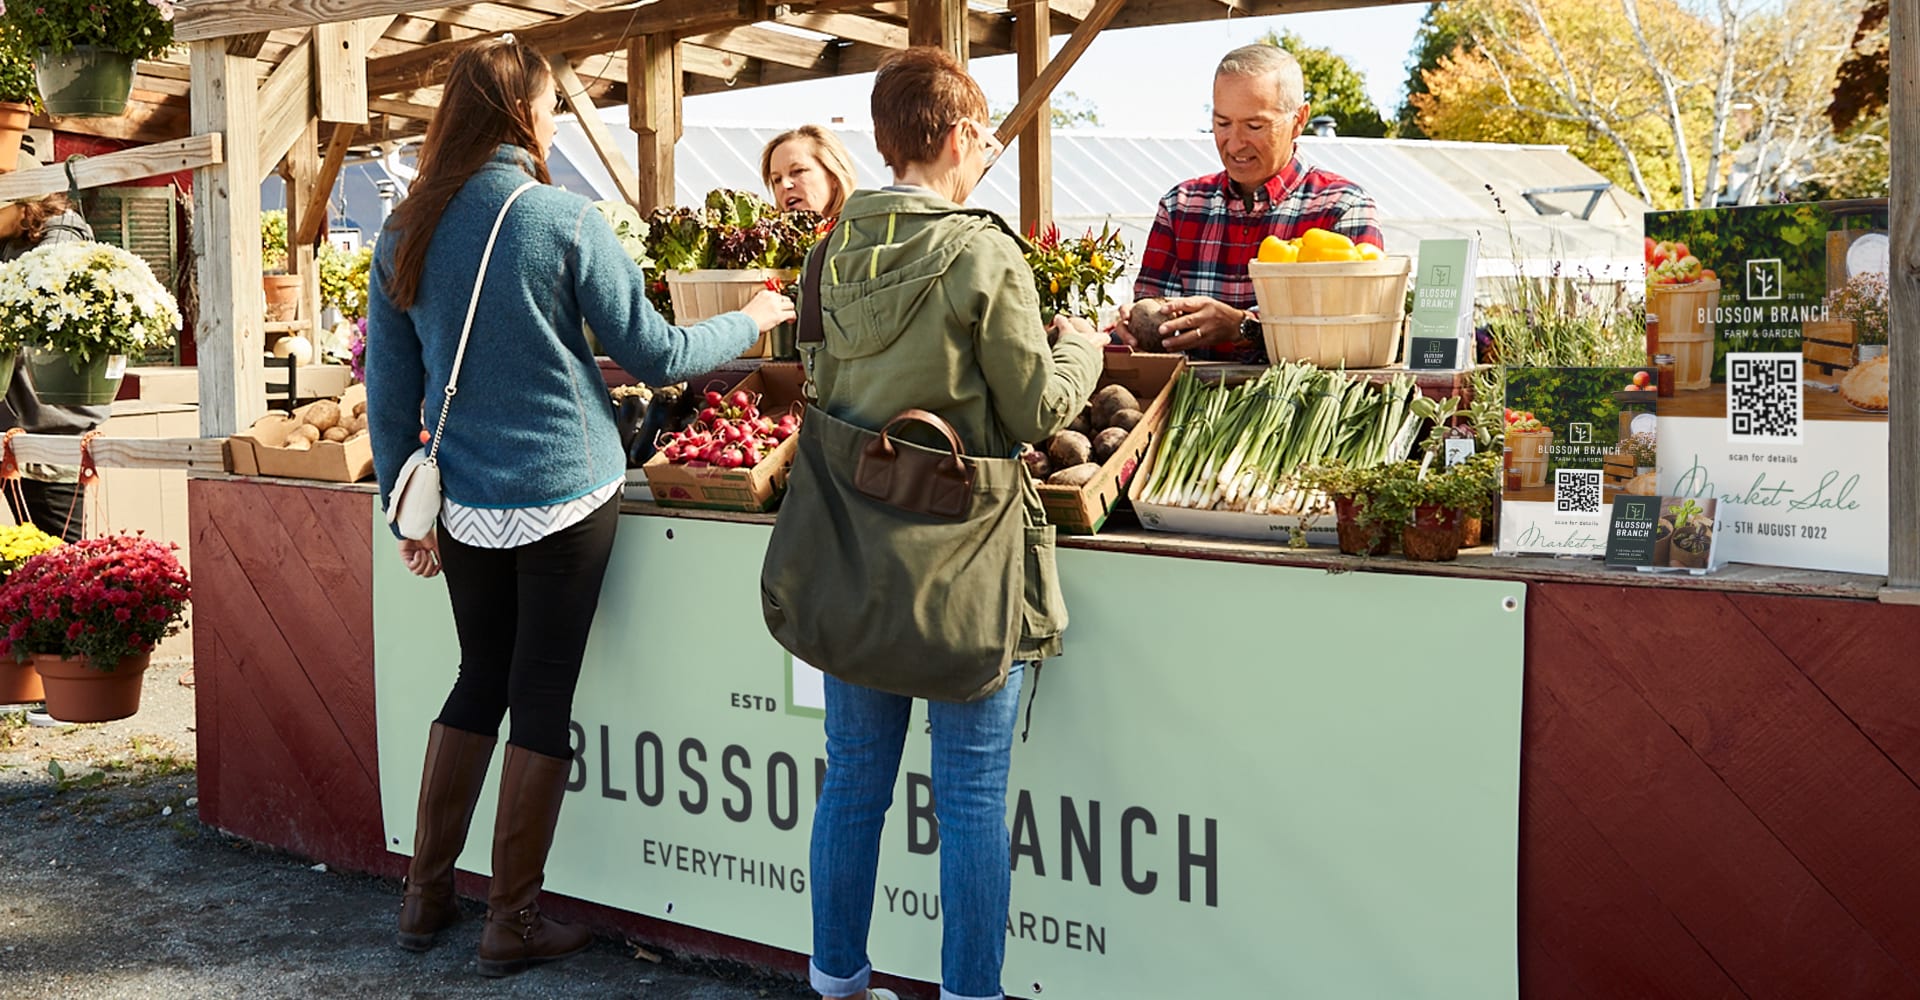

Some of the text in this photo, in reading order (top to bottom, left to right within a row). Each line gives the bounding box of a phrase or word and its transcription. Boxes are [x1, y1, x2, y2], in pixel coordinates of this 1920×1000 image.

[1420, 288, 1457, 298] BLOSSOM
[1420, 298, 1454, 309] BRANCH
[1697, 305, 1830, 324] BLOSSOM BRANCH
[1724, 328, 1801, 339] FARM & GARDEN
[1538, 444, 1620, 456] BLOSSOM BRANCH
[1729, 453, 1798, 464] scan for details
[1673, 453, 1861, 513] Market Sale
[1615, 520, 1653, 530] BLOSSOM
[1735, 520, 1753, 534] 5TH
[1757, 522, 1797, 537] AUGUST
[1801, 525, 1828, 540] 2022
[1516, 520, 1597, 549] Market
[1616, 529, 1649, 537] BRANCH
[730, 692, 777, 712] ESTD
[565, 719, 1219, 908] BLOSSO BANCH
[643, 838, 806, 894] EVERYTHING
[883, 885, 939, 921] YOU
